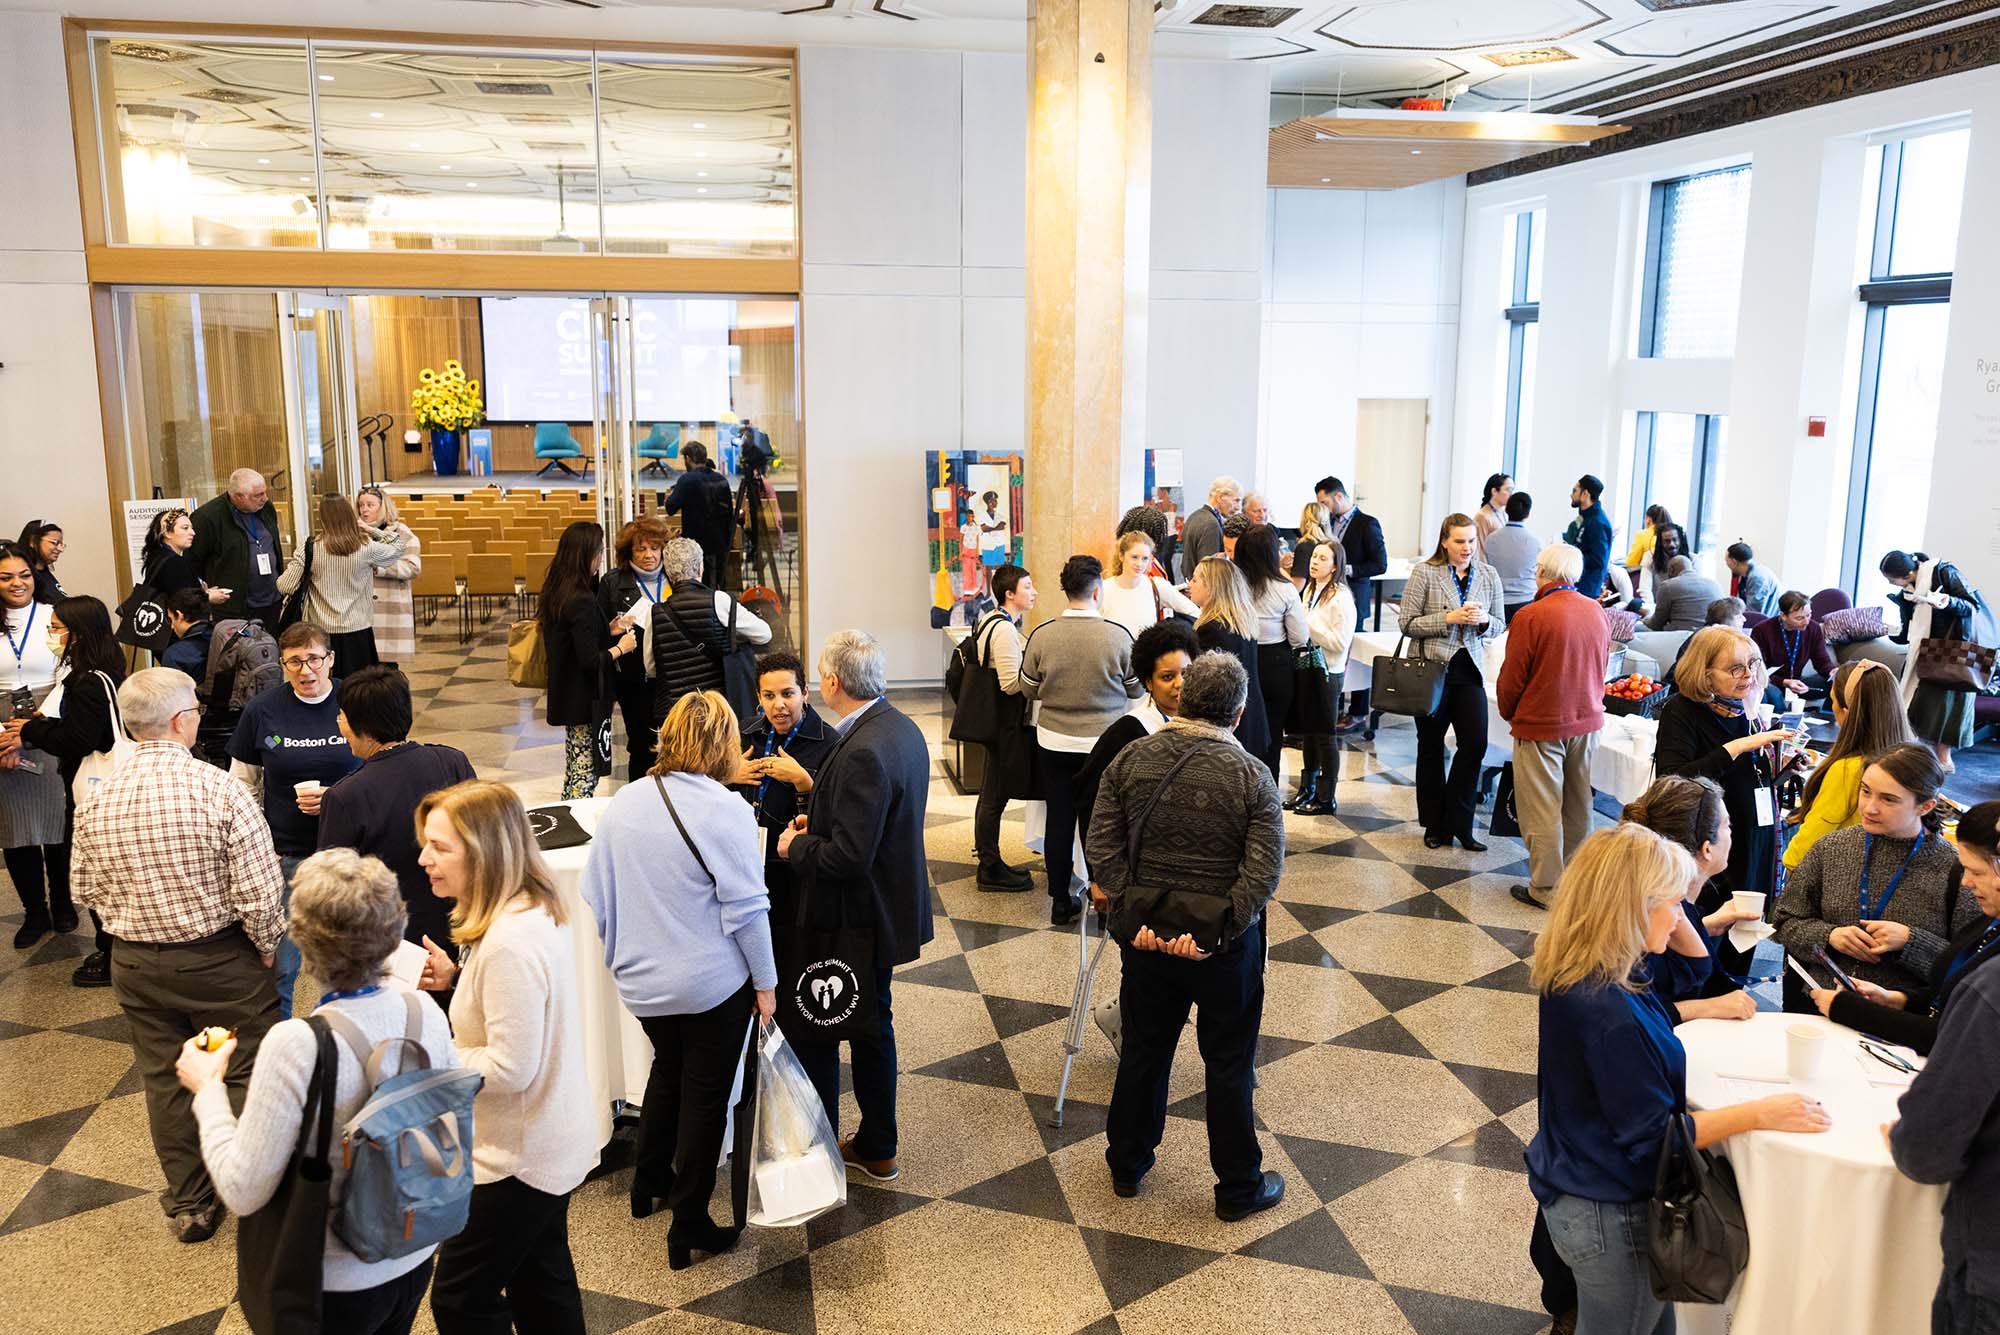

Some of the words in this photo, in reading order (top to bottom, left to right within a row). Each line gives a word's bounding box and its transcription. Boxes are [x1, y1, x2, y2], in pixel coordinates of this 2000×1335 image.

[283, 737, 326, 747] Boston
[806, 961, 823, 973] CIVIC
[824, 958, 852, 973] SUMMIT
[795, 995, 814, 1021] MAYOR
[814, 1007, 853, 1026] MICHELLE
[849, 994, 860, 1009] WU
